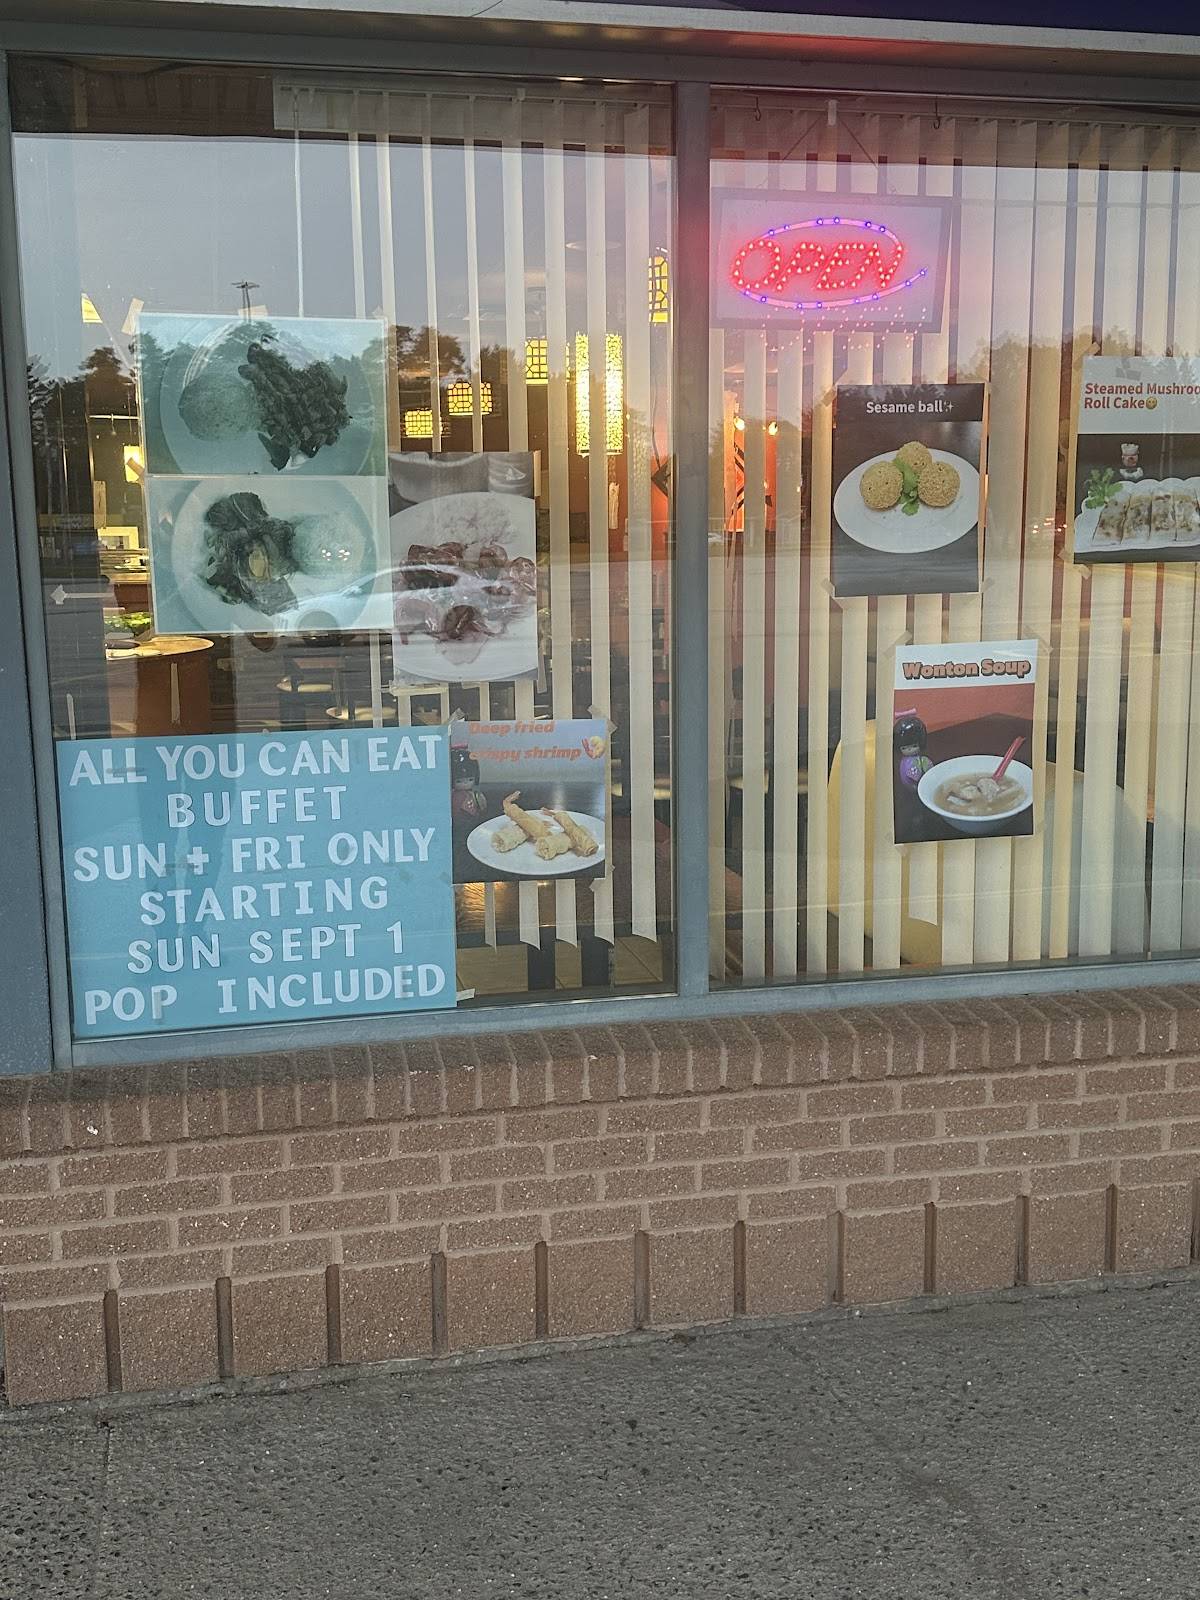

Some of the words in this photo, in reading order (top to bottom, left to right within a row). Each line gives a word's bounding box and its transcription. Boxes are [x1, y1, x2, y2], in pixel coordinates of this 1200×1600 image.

[731, 239, 905, 291] OPEN
[866, 400, 915, 414] Sesame
[918, 399, 943, 413] ball
[1084, 382, 1143, 395] Steamed
[1084, 396, 1111, 409] Roll
[1113, 397, 1145, 409] Cake
[902, 661, 980, 680] Wonton
[980, 658, 1032, 678] Soup
[468, 720, 511, 737] Deep
[514, 719, 555, 734] fried
[69, 747, 147, 786] ALL
[156, 743, 245, 781] YOU
[258, 738, 350, 776] CAN
[368, 734, 442, 772] EAT
[524, 745, 581, 761] shrimp
[167, 785, 347, 828] BUFFET
[73, 842, 166, 882] SUN
[186, 846, 210, 875] +
[231, 834, 306, 873] FRI
[327, 827, 436, 866] ONLY
[140, 876, 388, 926] STARTING
[127, 934, 221, 974] SUN
[249, 923, 362, 964] SEPT
[386, 920, 403, 954] 1
[85, 985, 177, 1025] POP
[217, 963, 446, 1014] INCLUDED
